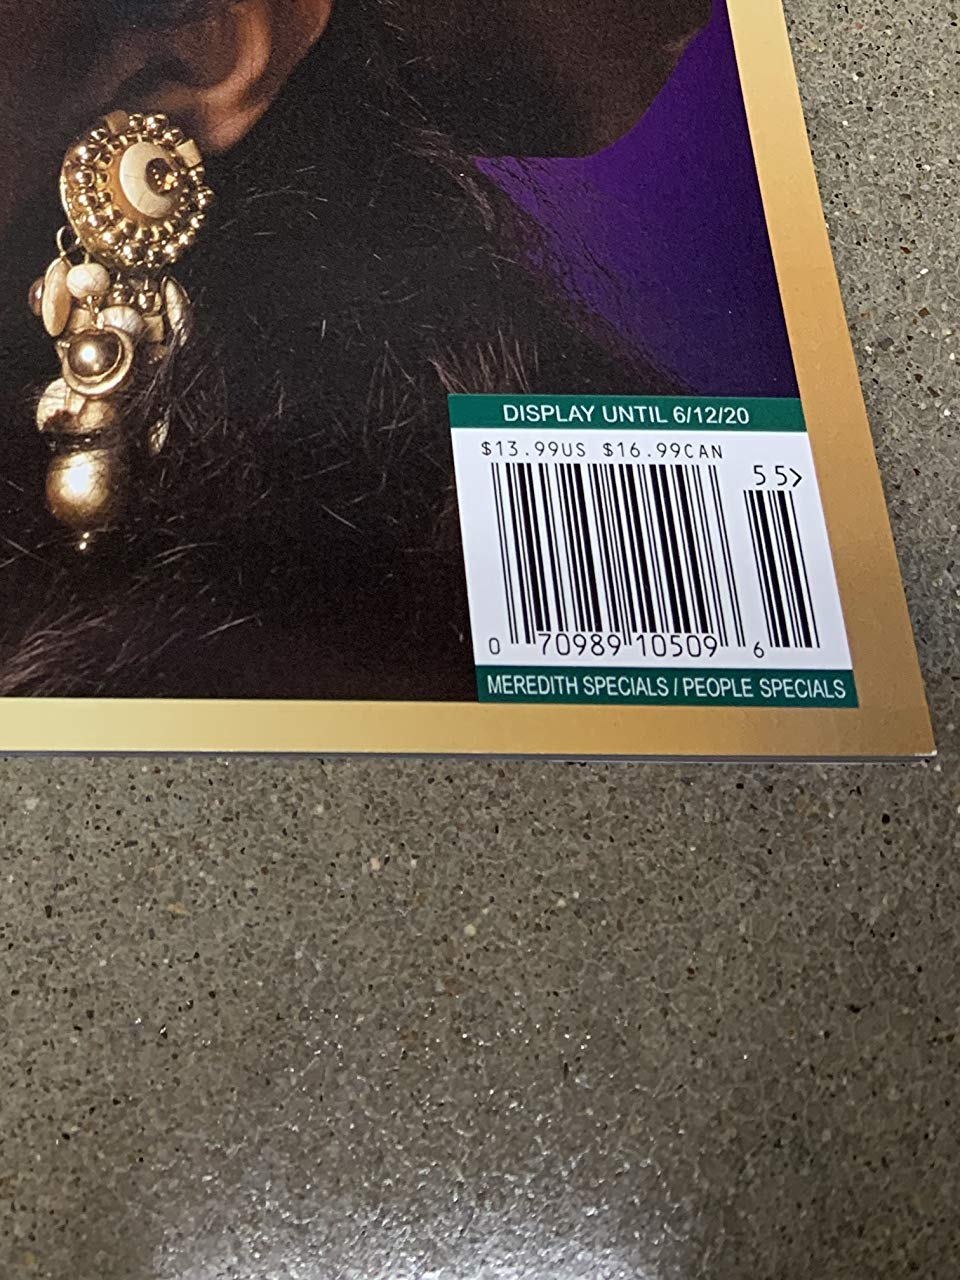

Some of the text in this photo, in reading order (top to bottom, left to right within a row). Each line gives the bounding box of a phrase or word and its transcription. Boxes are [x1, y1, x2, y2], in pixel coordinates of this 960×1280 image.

[503, 405, 749, 424] DISPLAY UNTIL 6/12/20
[481, 441, 723, 459] $13.99US $16.99CAN
[489, 634, 764, 658] 0 70989 10509 6
[487, 675, 846, 699] MEREDITH SPECIALS / PEOPLE SPECIALS
